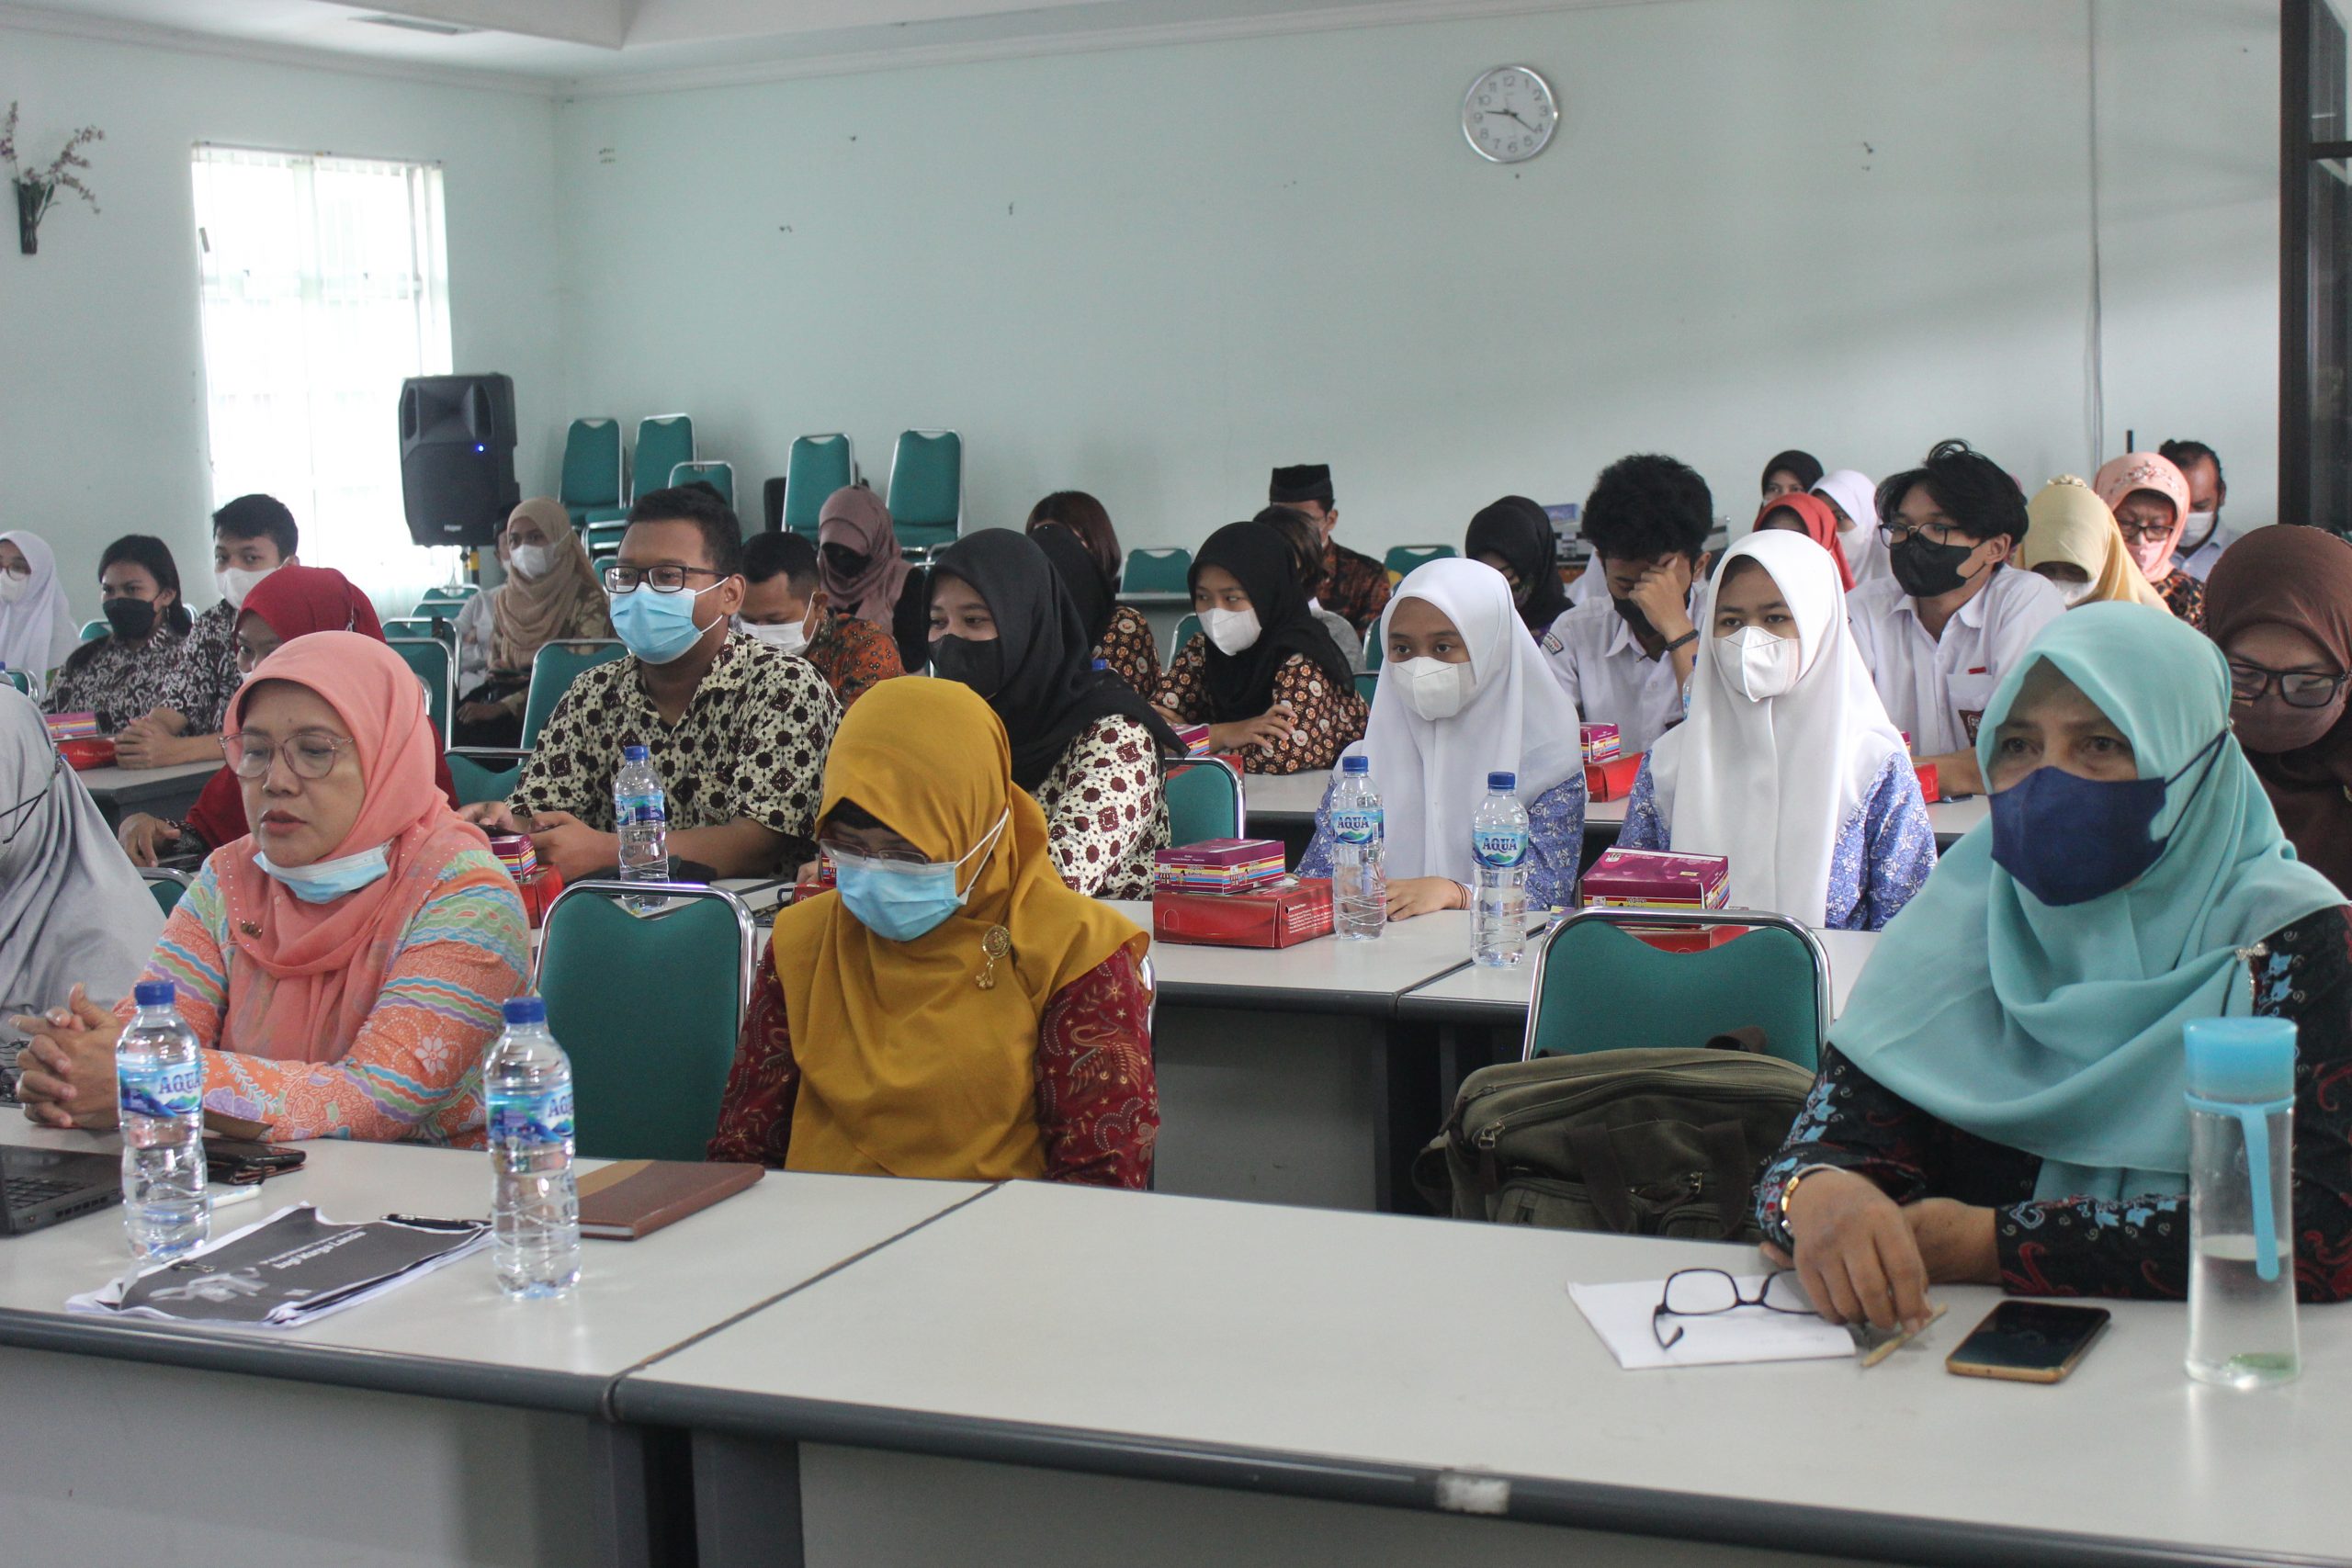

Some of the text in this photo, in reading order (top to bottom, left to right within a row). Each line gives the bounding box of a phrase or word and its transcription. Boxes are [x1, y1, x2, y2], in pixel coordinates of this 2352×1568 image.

[1503, 75, 1515, 87] 12
[1478, 95, 1491, 106] 10
[1532, 89, 1543, 101] 2
[1474, 112, 1483, 123] 9
[1540, 106, 1548, 117] 3
[1480, 128, 1488, 140] 8
[1535, 123, 1543, 134] 4
[1493, 138, 1500, 150] 7
[1508, 141, 1518, 153] 6
[1338, 817, 1369, 830] AQUA
[1483, 837, 1517, 853] AQUA
